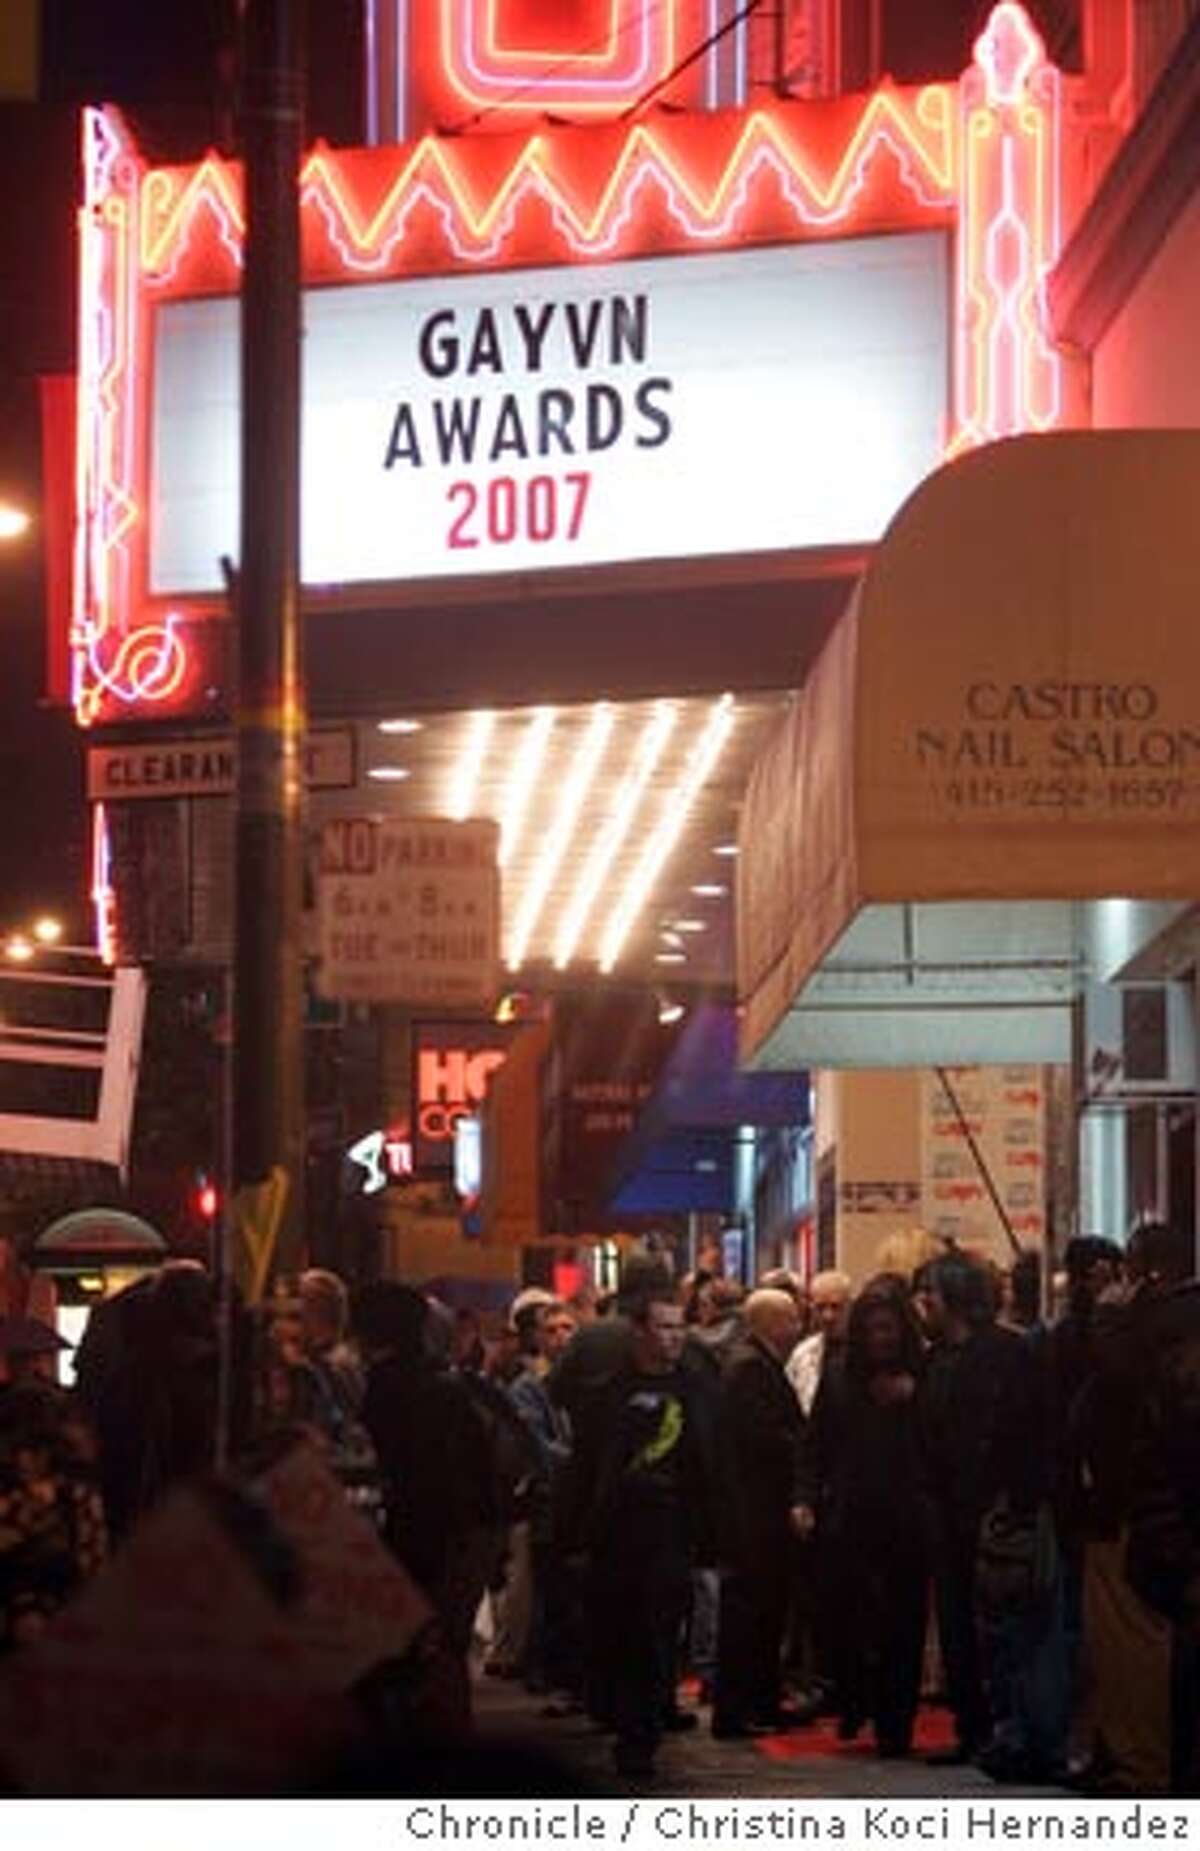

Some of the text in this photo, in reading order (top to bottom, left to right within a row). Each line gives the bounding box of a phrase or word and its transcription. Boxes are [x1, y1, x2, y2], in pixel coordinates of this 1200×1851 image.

[418, 294, 648, 379] GAYVN
[383, 377, 673, 470] AWARDS
[446, 471, 593, 550] 2007
[966, 681, 1158, 720] CASTRO
[106, 753, 235, 787] CLEARAN
[916, 728, 1028, 767] NAIL
[320, 822, 376, 874] NO
[418, 1051, 507, 1102] HO
